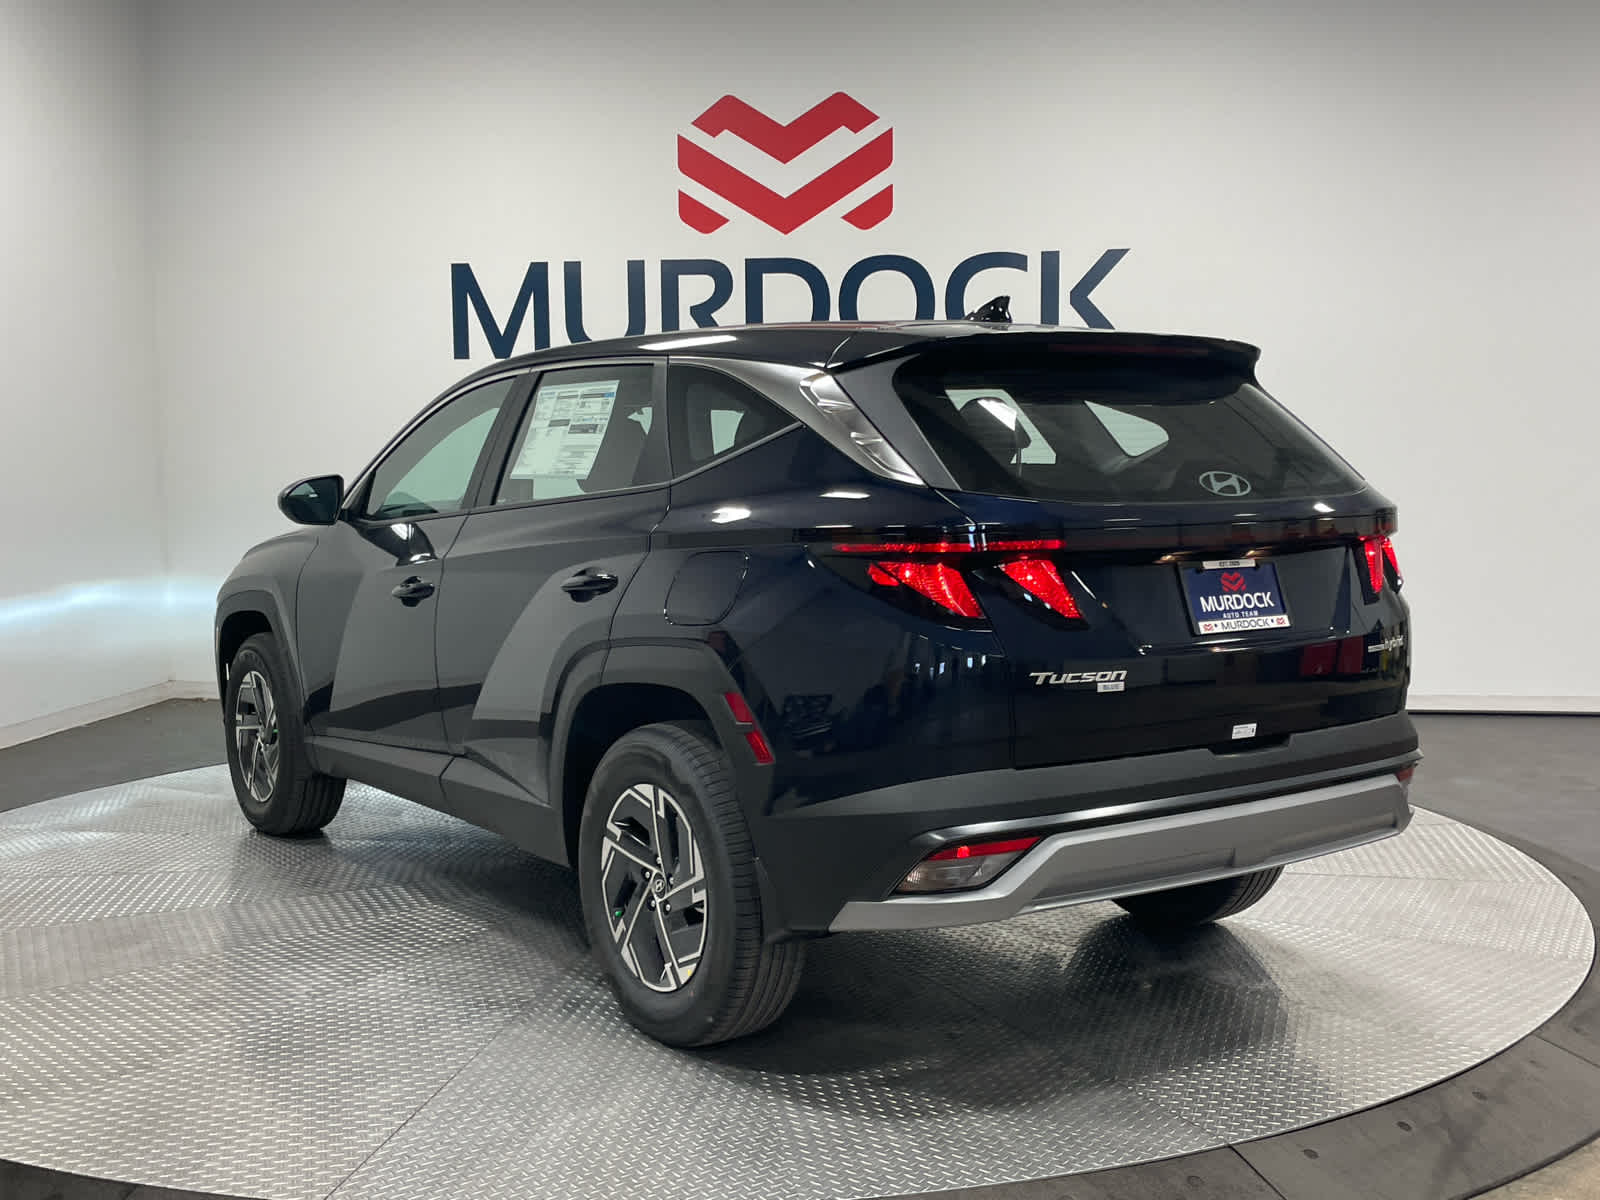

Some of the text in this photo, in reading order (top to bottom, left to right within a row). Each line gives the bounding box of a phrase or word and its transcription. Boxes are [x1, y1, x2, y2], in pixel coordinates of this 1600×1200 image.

[451, 248, 1131, 360] MURDOCK
[1200, 592, 1274, 612] MURDOCK
[1222, 610, 1240, 619] AUTO
[1221, 619, 1269, 631] MURDOCK
